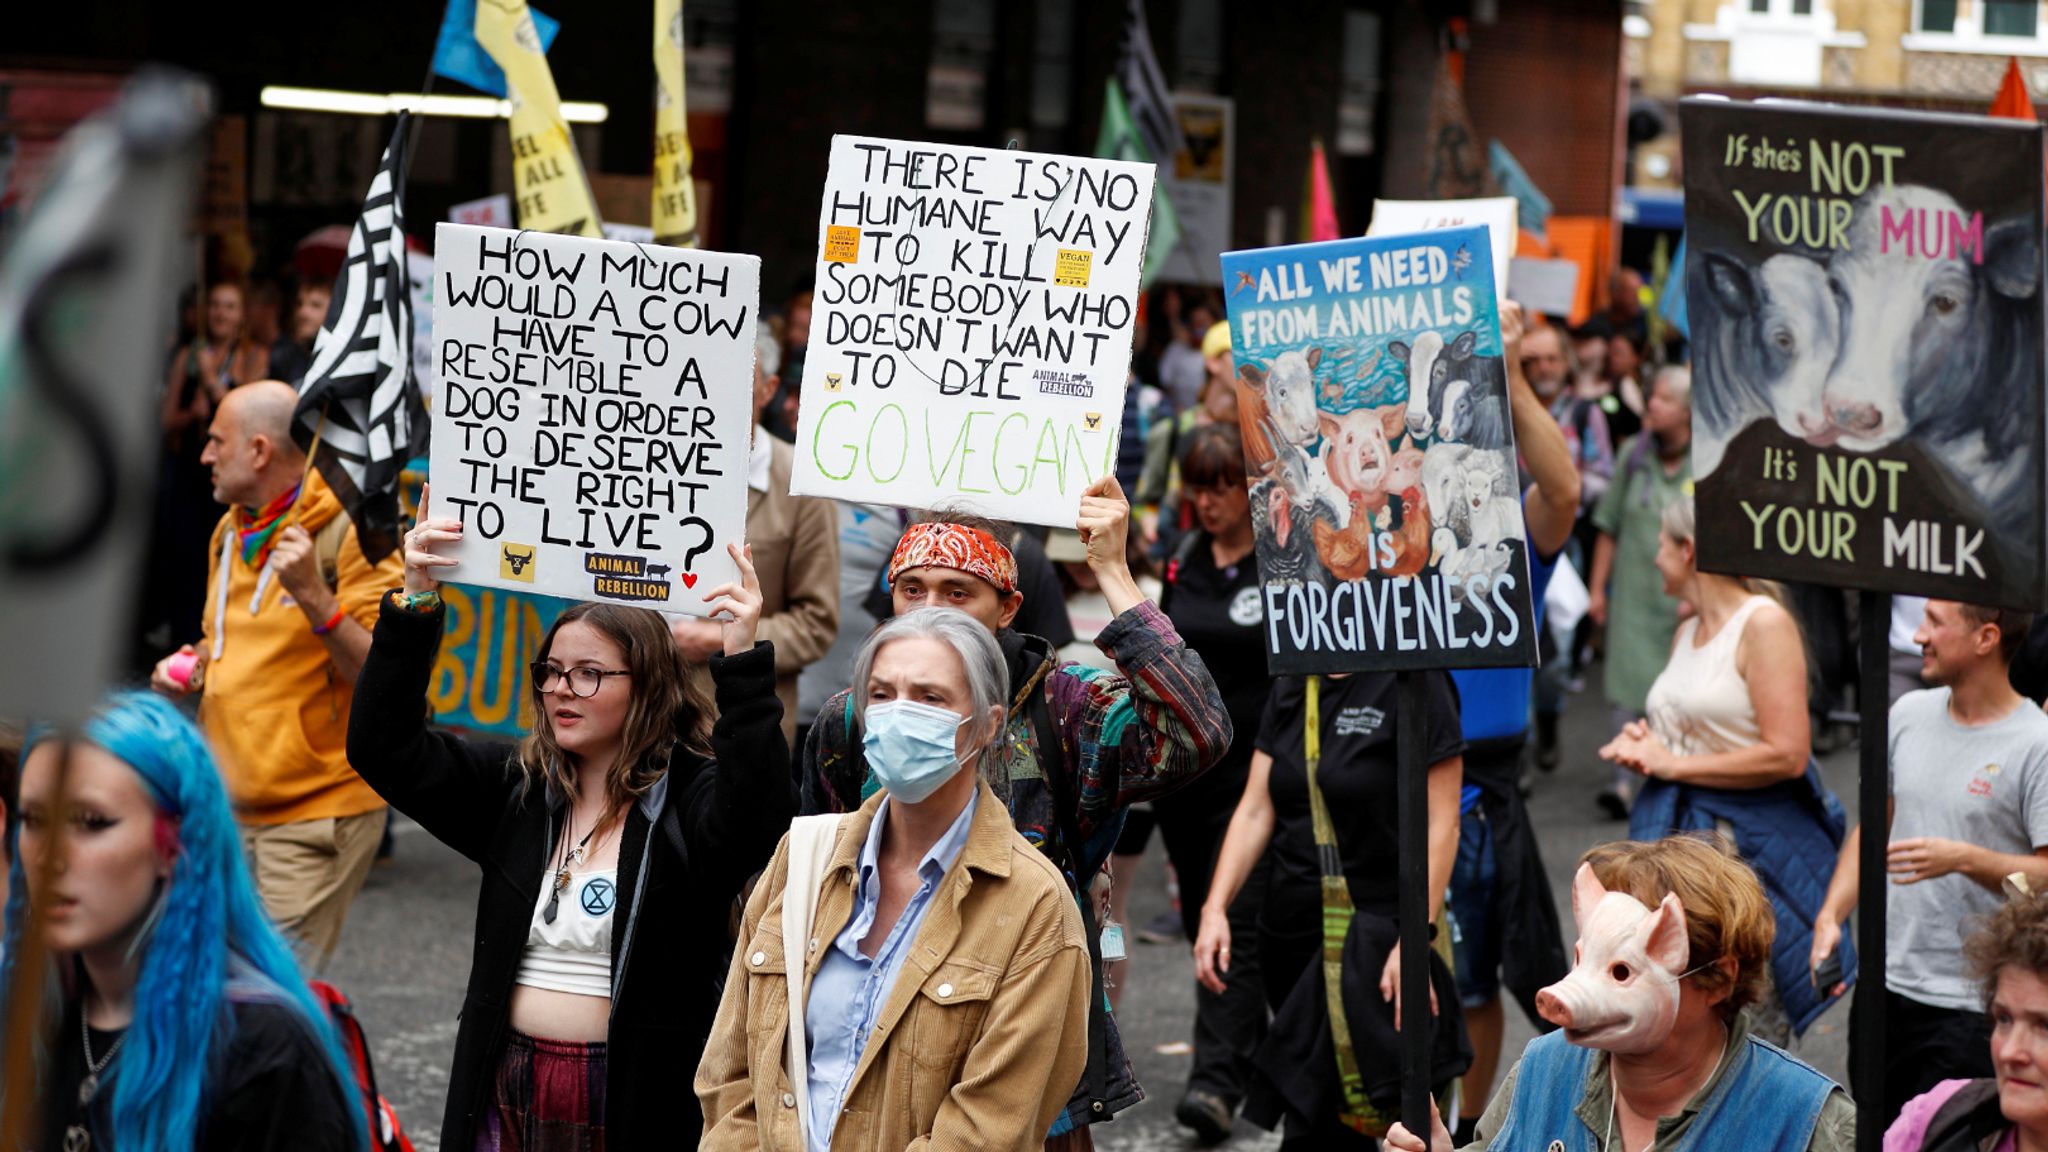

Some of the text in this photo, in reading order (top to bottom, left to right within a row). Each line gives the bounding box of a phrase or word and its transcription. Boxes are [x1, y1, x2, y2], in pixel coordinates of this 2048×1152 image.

[526, 157, 564, 187] ALL
[854, 144, 1139, 210] THERE IS NO
[1810, 139, 1905, 196] NOT
[831, 191, 1130, 265] HUMANE WAY
[1733, 190, 1984, 265] YOUR MUM
[479, 236, 729, 297] HOW MUCH
[864, 232, 1045, 282] TO KILL
[1061, 253, 1089, 261] VEGAN
[1256, 246, 1448, 303] ALL WE NEED
[447, 272, 746, 339] WOULD A COW
[822, 262, 1130, 329] SOMEBODY WHO
[1241, 286, 1473, 349] FROM ANIMALS
[495, 317, 668, 366] HAVE TO
[827, 312, 1109, 365] DOESN'T WANT
[442, 340, 707, 399] RESEMBLE A
[843, 351, 1023, 400] TO DIE
[1033, 370, 1069, 382] ANIMAL
[1041, 382, 1091, 397] REBELLION
[446, 382, 715, 439] DOG IN ORDER
[455, 422, 722, 476] TO DESERVE
[813, 401, 1114, 498] GO VEGAN
[461, 459, 545, 504] THE
[577, 472, 708, 513] RIGHT
[1817, 453, 1908, 513] NOT
[447, 498, 504, 539] TO
[1740, 501, 1987, 579] YOUR MILK
[589, 556, 640, 574] ANIMAL
[1368, 532, 1396, 569] IS
[598, 579, 667, 599] REBELLION
[1266, 573, 1520, 654] FORGIVENESS
